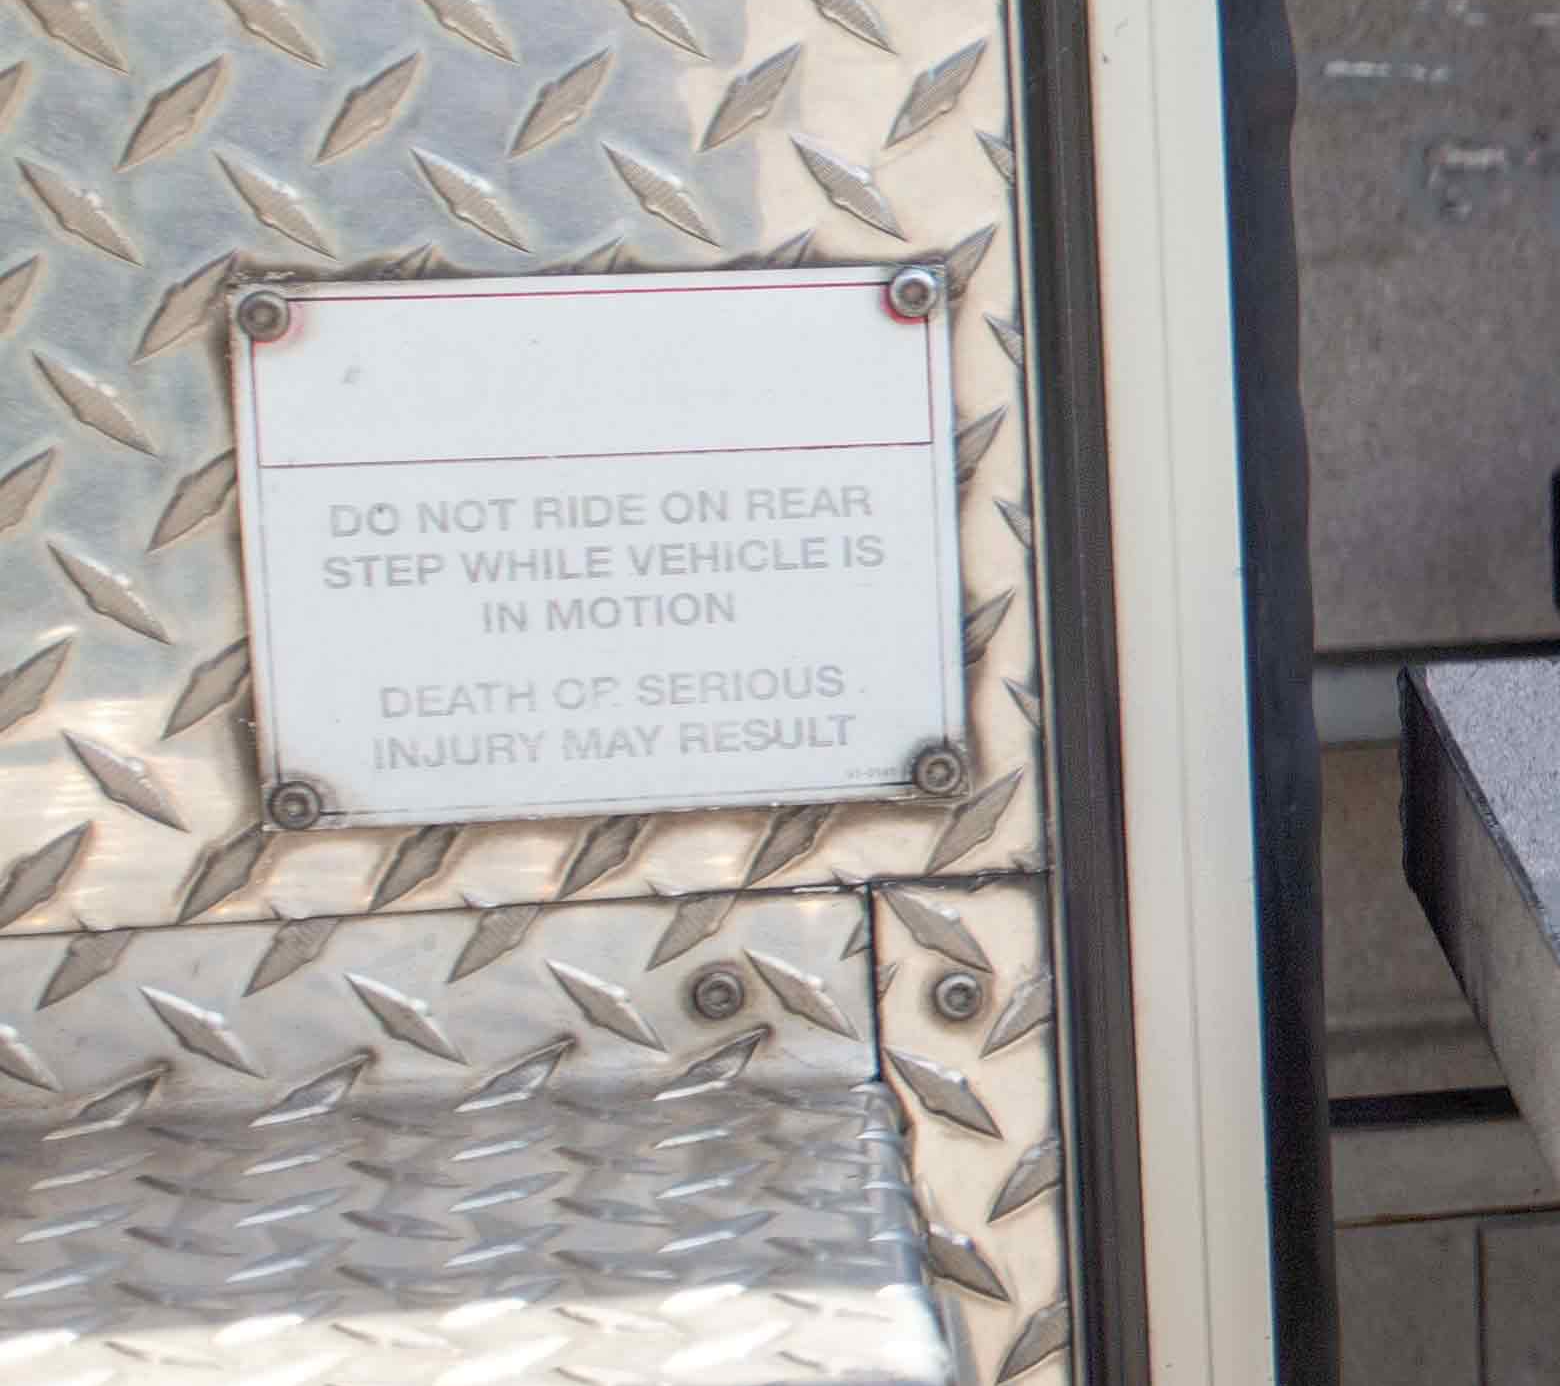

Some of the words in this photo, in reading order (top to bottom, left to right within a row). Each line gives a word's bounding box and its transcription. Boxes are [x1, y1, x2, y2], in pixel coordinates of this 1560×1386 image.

[328, 502, 400, 538] DO
[417, 497, 516, 534] NOT
[532, 493, 647, 531] RIDE
[659, 490, 730, 526] ON
[746, 484, 874, 523] REAR
[322, 553, 445, 590] STEP
[460, 545, 614, 585] WHILE
[627, 536, 830, 578] VEHICLE
[842, 534, 886, 569] IS
[481, 599, 529, 634] IN
[545, 591, 737, 632] MOTION
[379, 680, 537, 719] DEATH
[636, 665, 846, 707] SERIOUS
[372, 730, 546, 771] INJURY
[561, 723, 664, 762] MAY
[678, 713, 857, 756] RESULT
